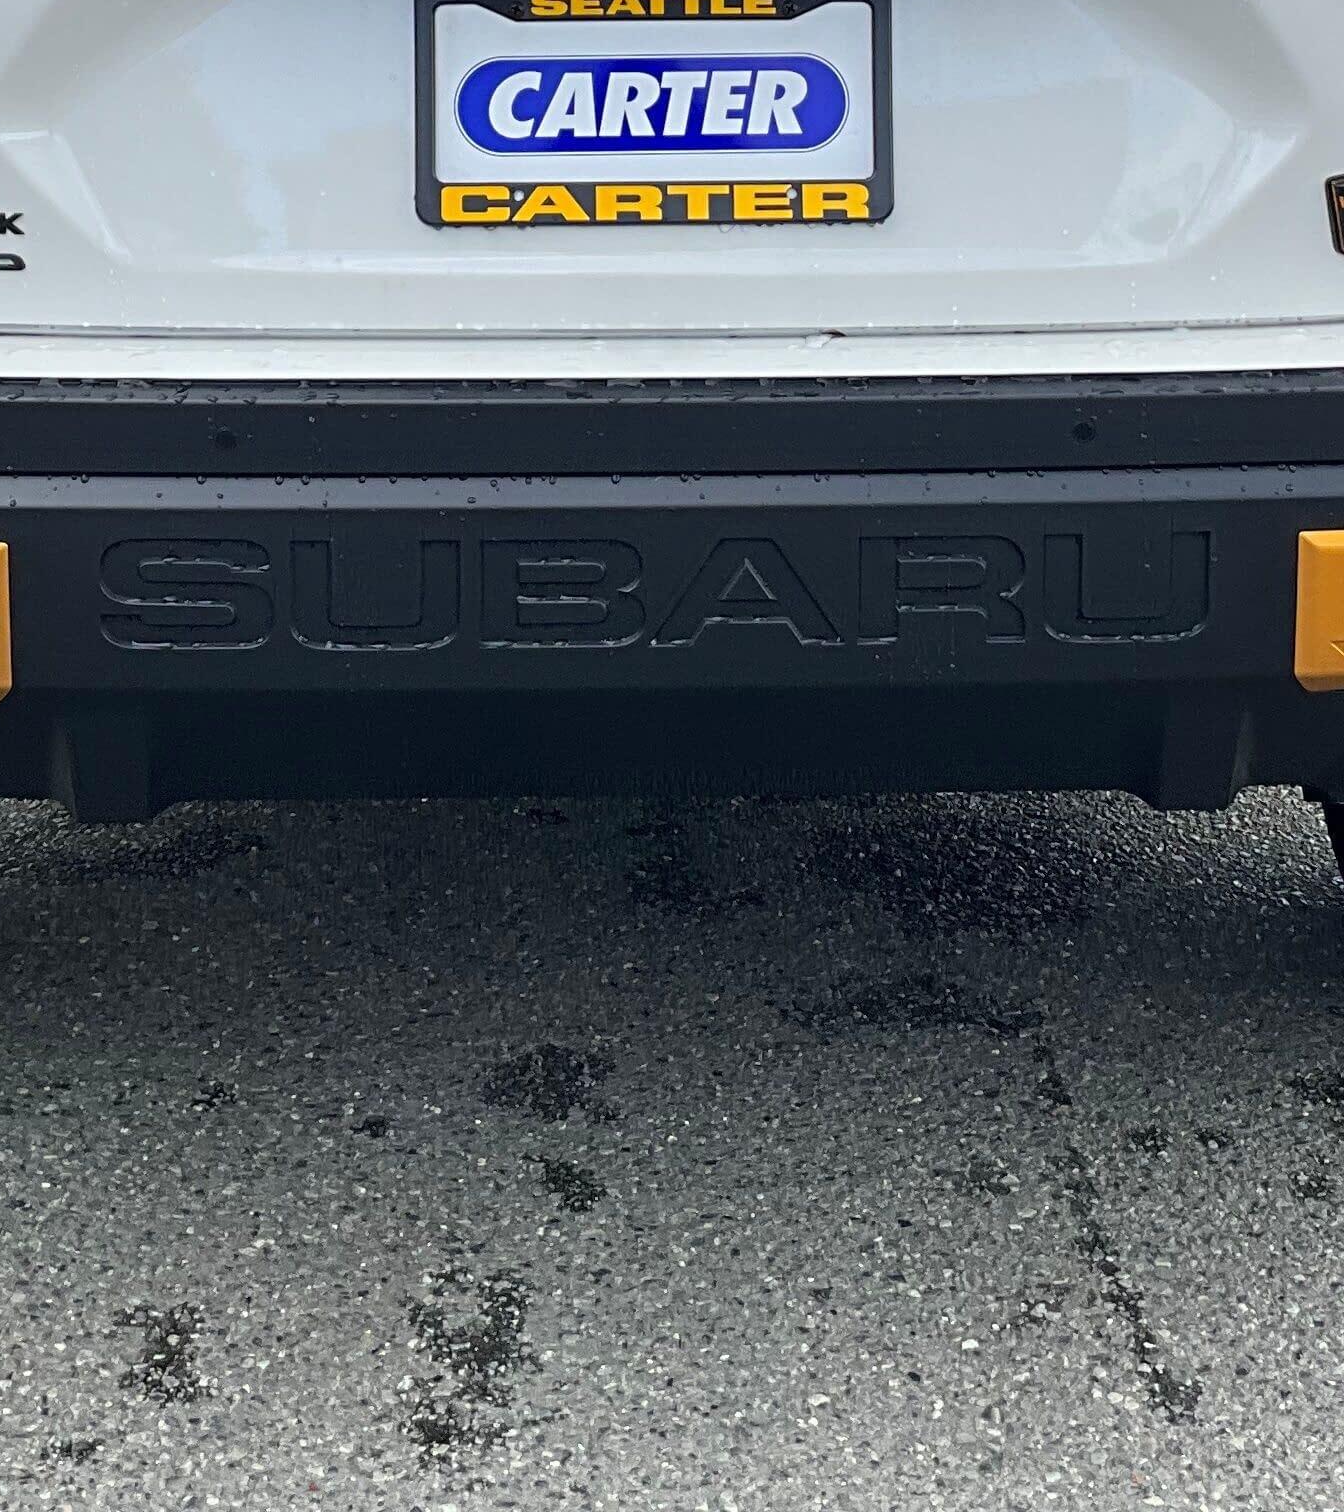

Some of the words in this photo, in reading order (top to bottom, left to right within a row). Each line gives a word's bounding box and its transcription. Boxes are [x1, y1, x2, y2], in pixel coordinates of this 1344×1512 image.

[487, 68, 809, 140] CARTER
[440, 182, 871, 223] CARTER
[99, 530, 1212, 650] SUBARU
